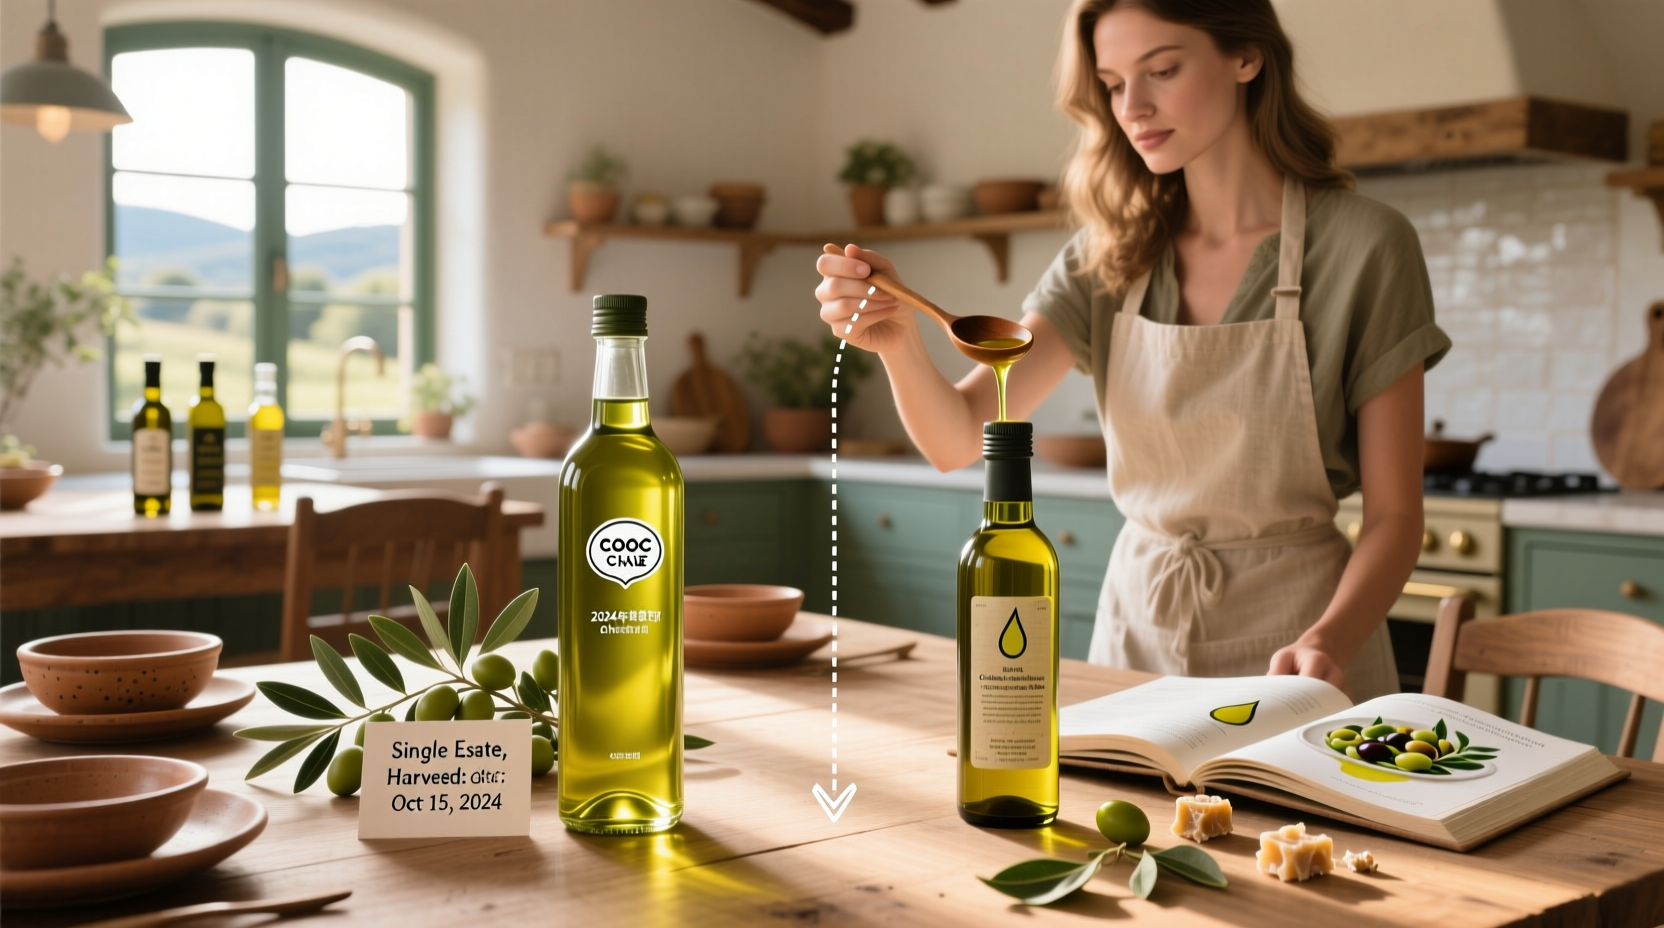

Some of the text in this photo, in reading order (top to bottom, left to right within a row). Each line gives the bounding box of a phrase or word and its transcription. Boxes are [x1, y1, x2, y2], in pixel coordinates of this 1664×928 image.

[600, 538, 651, 552] COOC
[392, 740, 507, 764] Single Esate,
[387, 767, 466, 785] Harveed:
[392, 793, 502, 815] Oct 15, 2024
